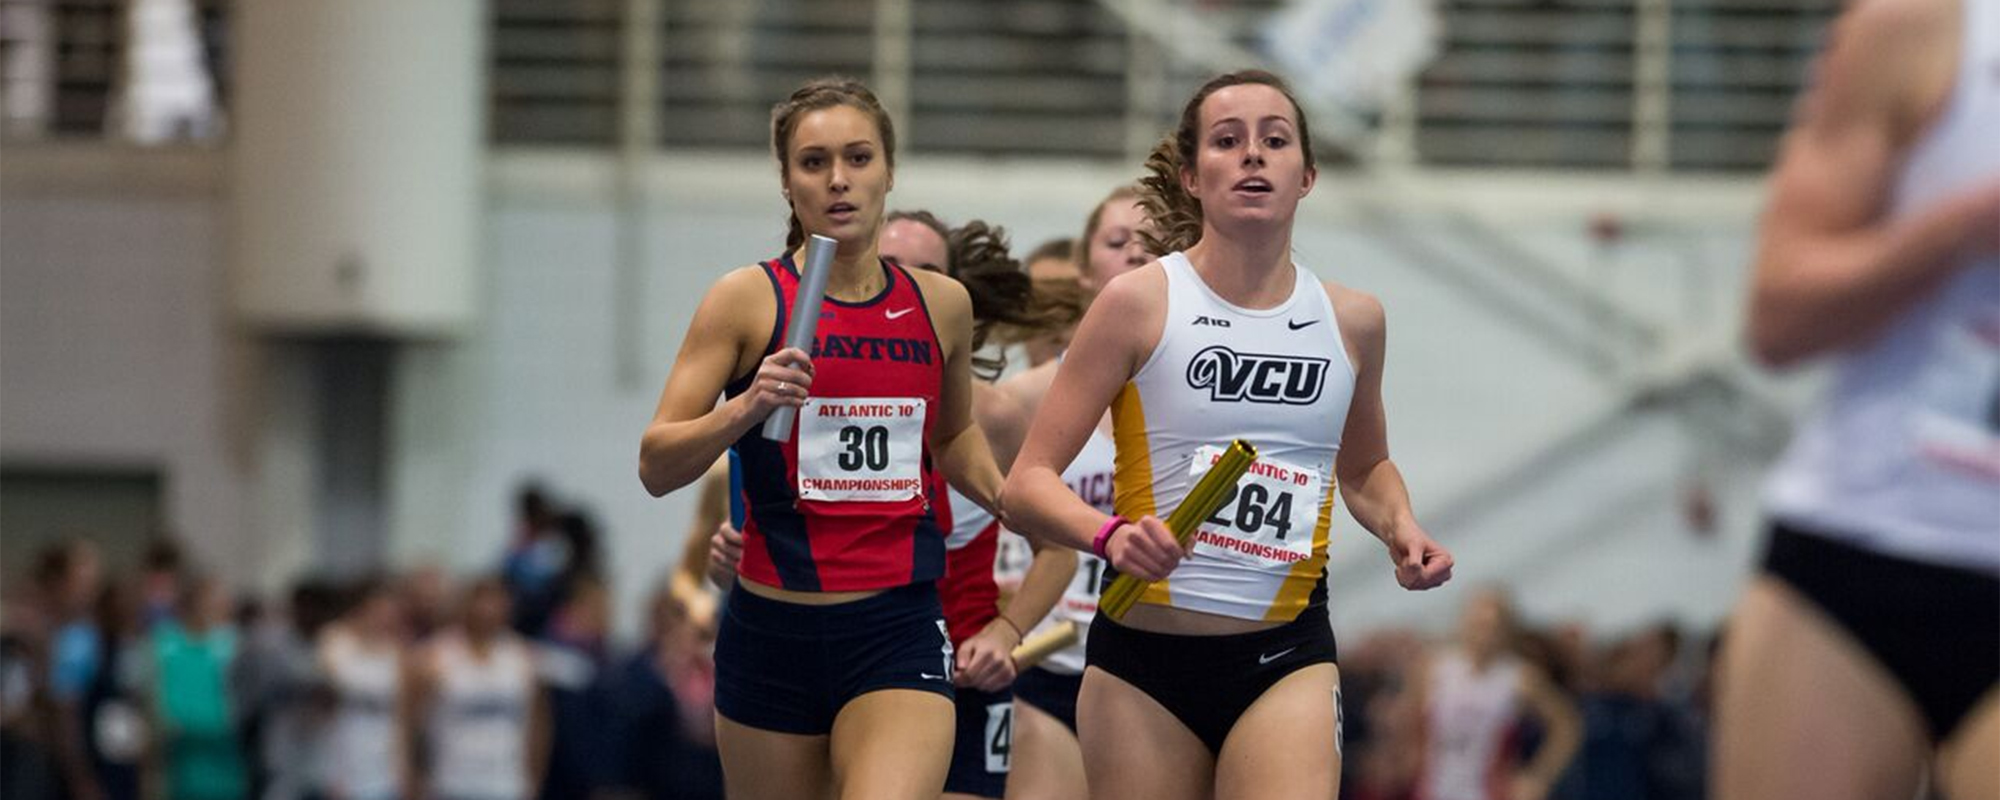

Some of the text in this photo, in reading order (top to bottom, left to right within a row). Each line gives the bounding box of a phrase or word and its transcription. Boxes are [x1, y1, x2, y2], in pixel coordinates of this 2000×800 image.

[1187, 345, 1331, 405] VCU
[818, 404, 914, 417] ATLANTIC 10
[838, 425, 889, 471] 30
[802, 478, 920, 491] CHAMPIONSHIPS
[1293, 471, 1309, 487] 10
[1194, 529, 1309, 563] AMPIONSHIPS
